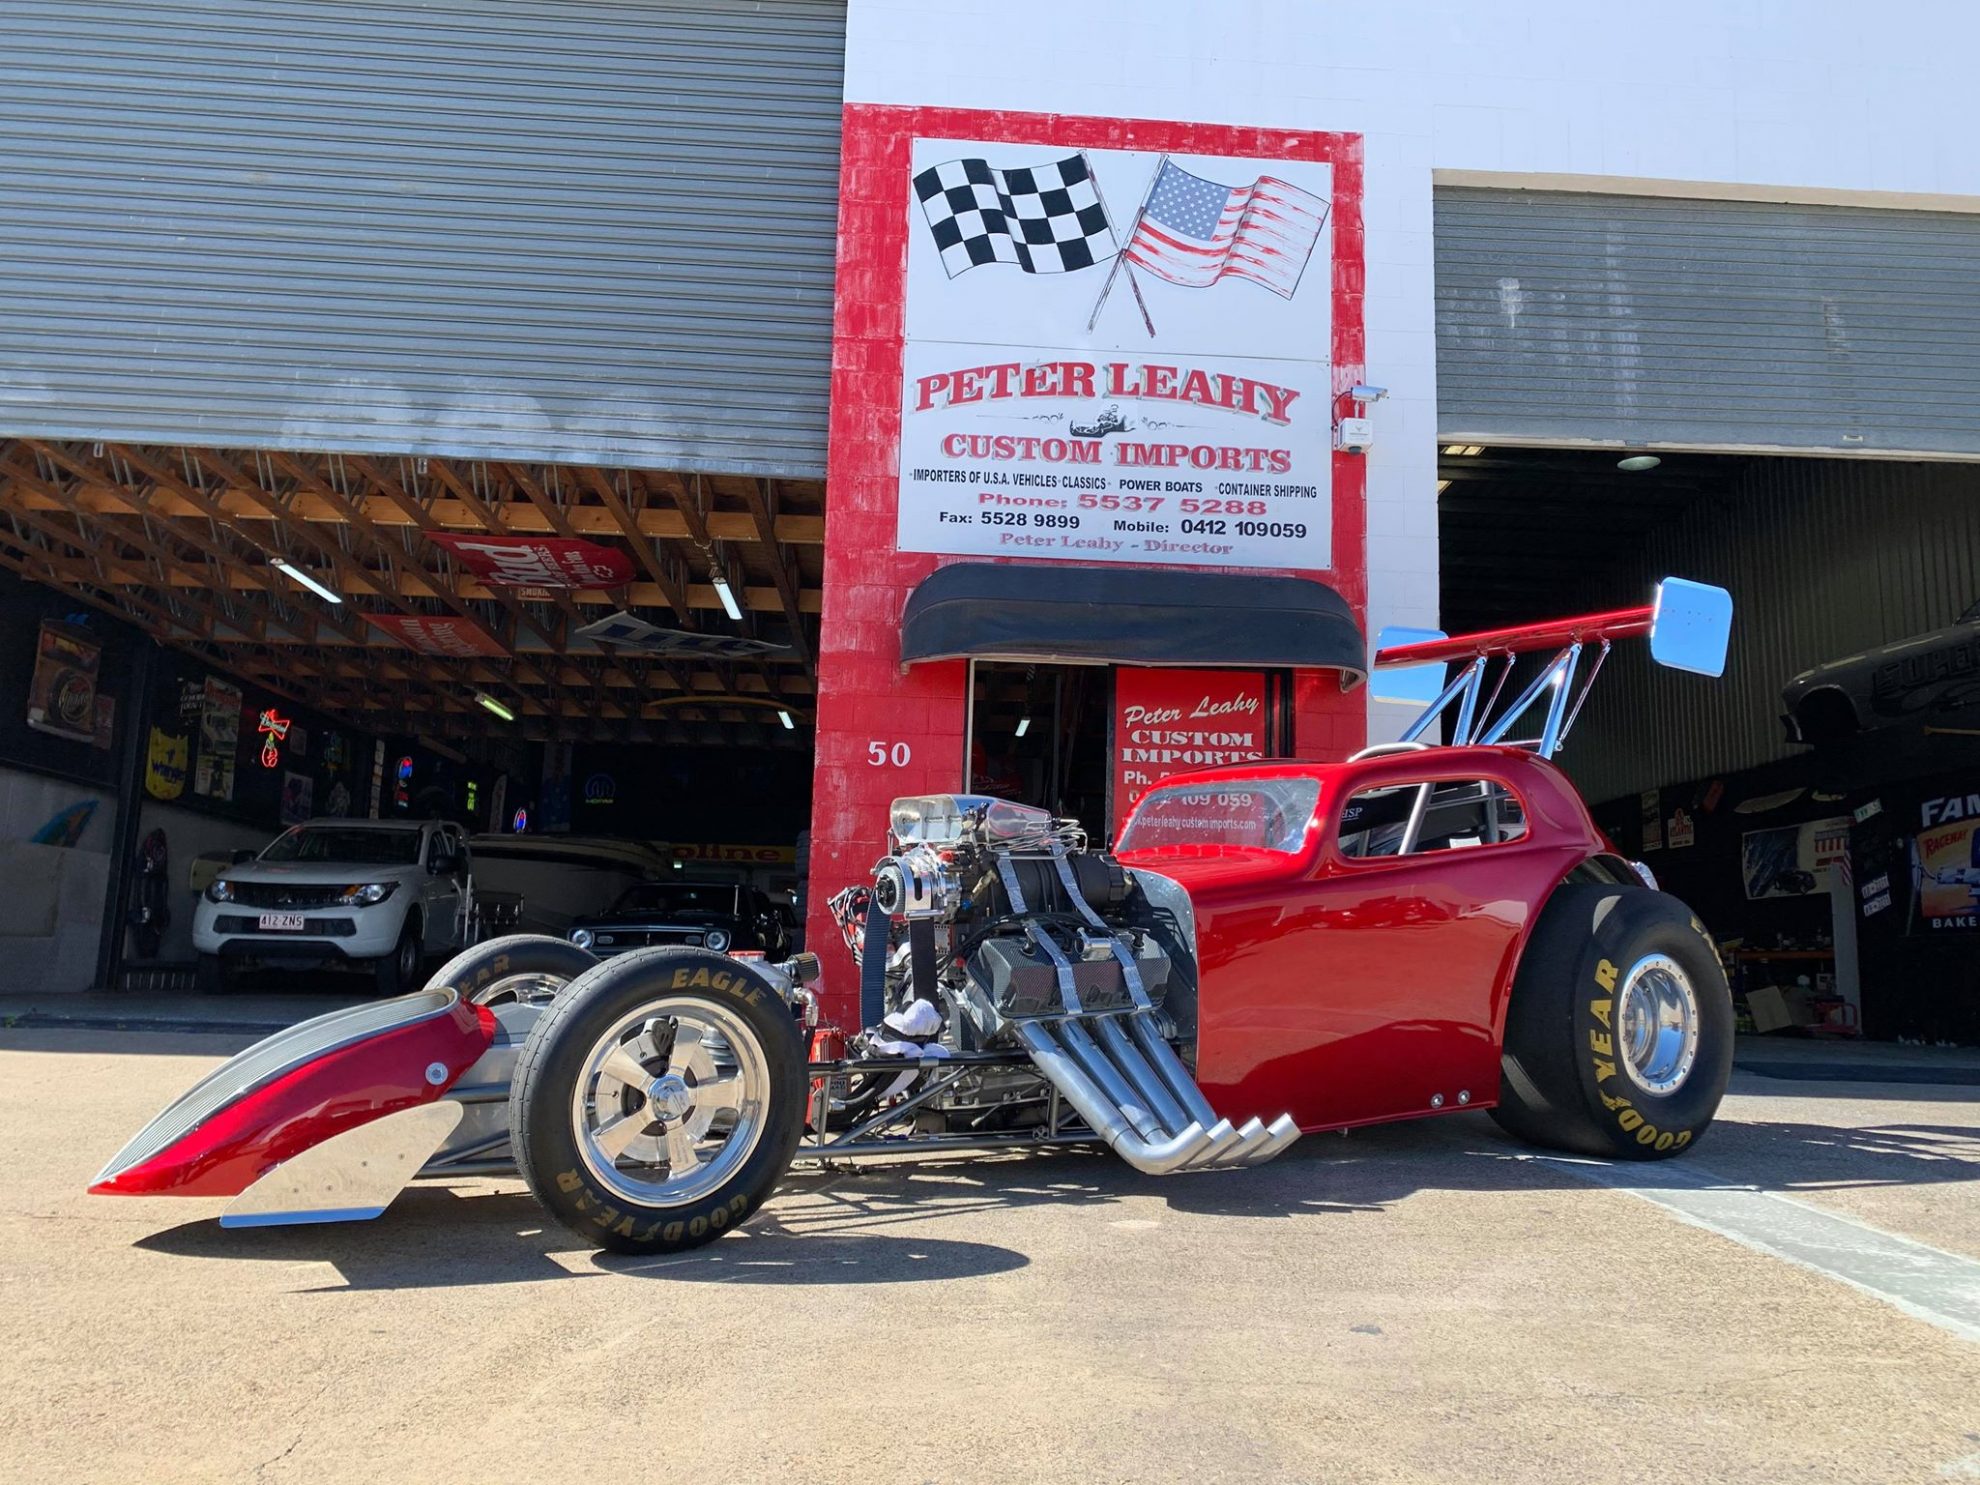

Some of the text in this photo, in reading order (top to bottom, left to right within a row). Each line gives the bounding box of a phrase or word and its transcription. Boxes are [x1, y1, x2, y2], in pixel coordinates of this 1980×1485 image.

[912, 361, 1300, 426] PETER LEAHY
[942, 433, 1291, 474] CUSTOM IMPORTS
[913, 469, 1317, 498] IMPORTERS OF U.S.A. VEHICLES CLASSICS POWER BOATS CONTAINER SHIPPING
[978, 493, 1267, 515] Phone: 5537 5288
[940, 511, 1307, 538] Fax: 5528 9899 Mobile: 0412 109059
[1000, 533, 1056, 547] Peter
[1061, 535, 1123, 552] Leahy
[1144, 540, 1234, 555] Director
[1124, 692, 1259, 728] Peter Leahy
[1131, 730, 1253, 747] CUSTOM
[867, 741, 911, 767] 50
[1122, 748, 1263, 764] IMPORTS
[1123, 771, 1152, 785] Ph.
[1217, 793, 1253, 806] 059
[671, 967, 770, 1007] EAGLE
[1589, 958, 1692, 1151] GOODYEAR
[556, 1167, 750, 1243] GOODYEAR
